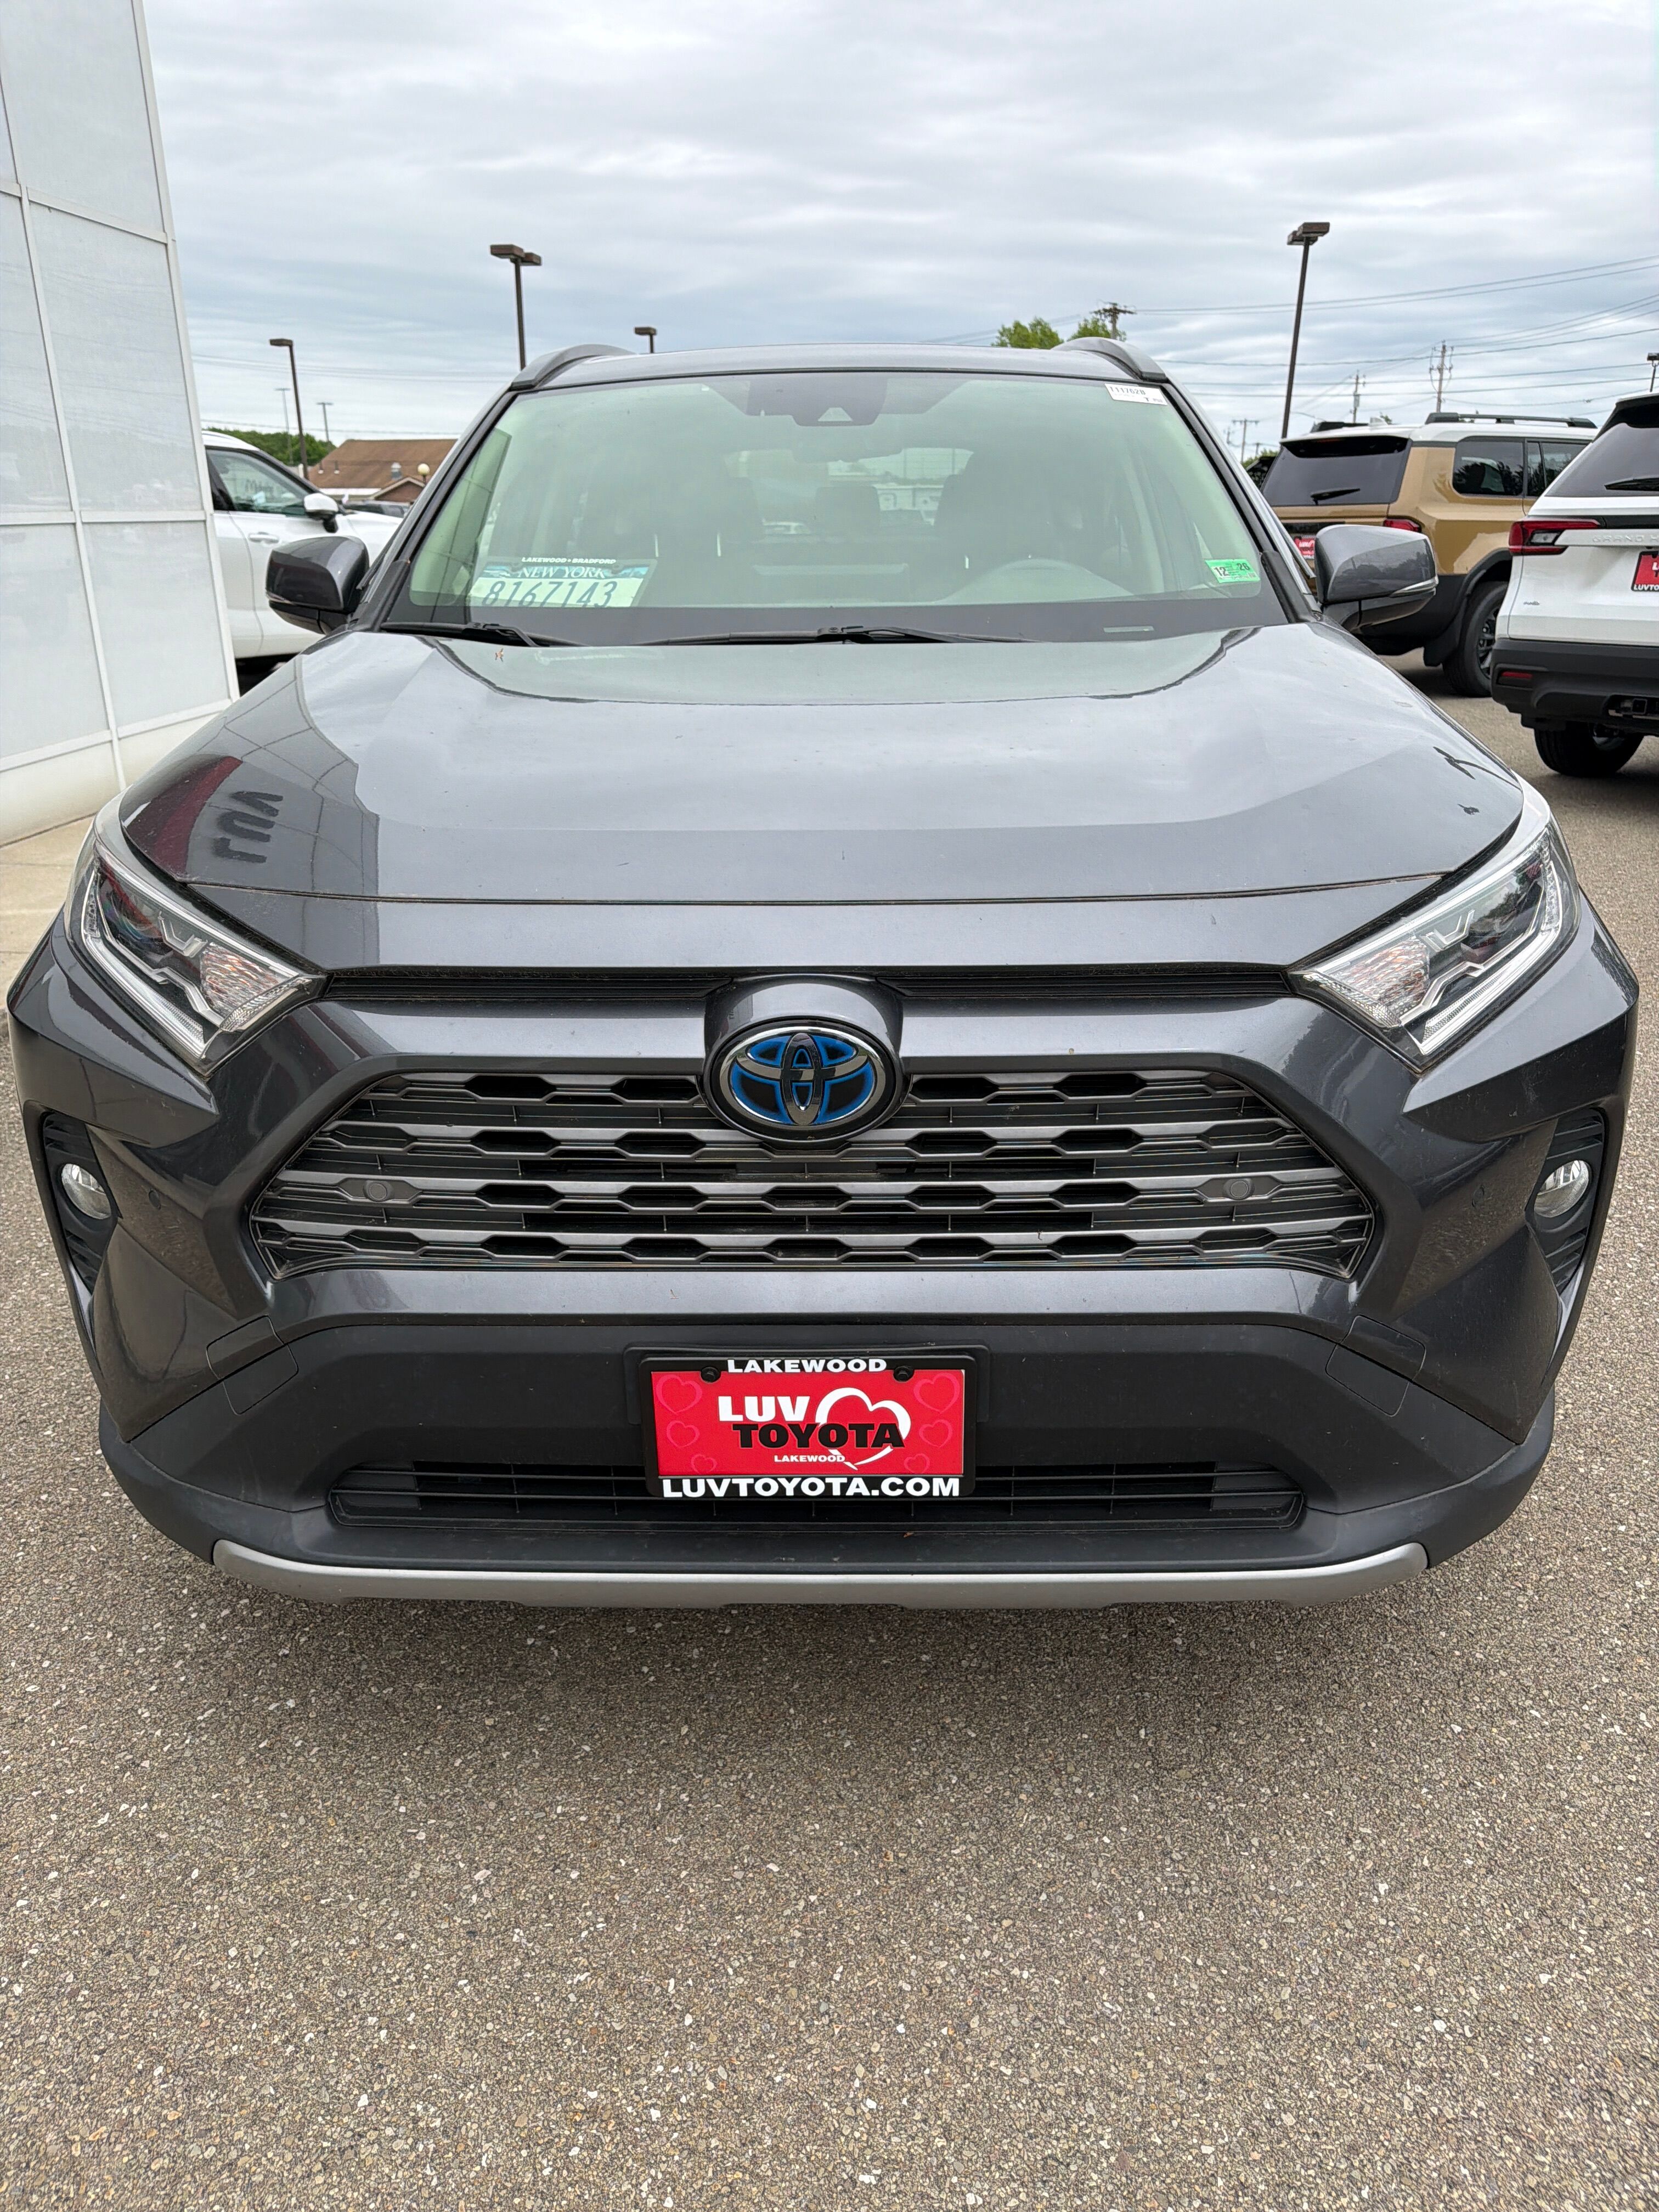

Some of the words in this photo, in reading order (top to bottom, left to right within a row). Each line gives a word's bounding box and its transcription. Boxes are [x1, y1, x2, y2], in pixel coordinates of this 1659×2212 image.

[518, 567, 558, 578] NEW
[563, 566, 605, 578] YORK
[1214, 566, 1229, 577] 12
[482, 580, 618, 607] 8167143
[727, 1359, 887, 1373] LAKEWOOD
[718, 1396, 810, 1422] LUV
[732, 1423, 905, 1448] TOYOTA
[662, 1477, 960, 1498] LUVTOYOTA.COM
